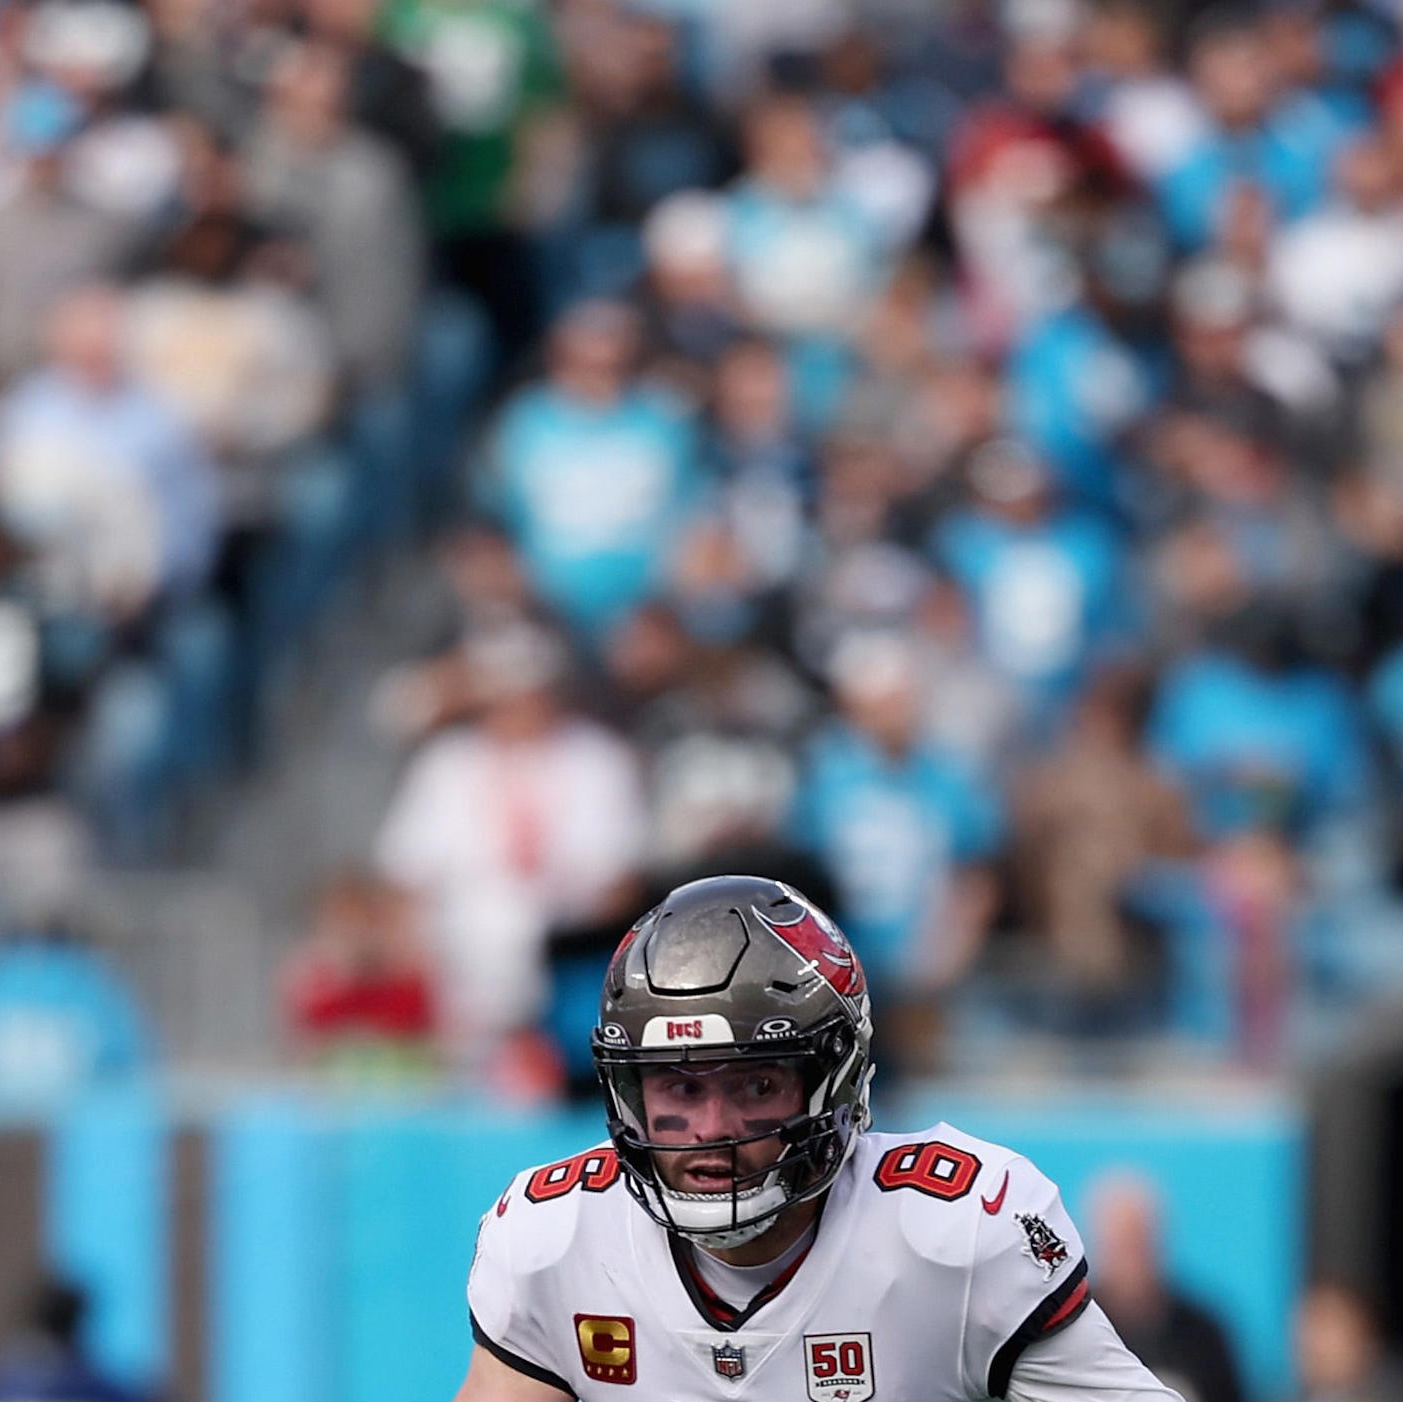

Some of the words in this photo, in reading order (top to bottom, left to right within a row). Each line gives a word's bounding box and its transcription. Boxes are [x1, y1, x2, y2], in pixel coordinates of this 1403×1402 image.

[666, 1020, 703, 1040] BUCS
[524, 1147, 621, 1205] 6
[872, 1141, 983, 1203] 6
[577, 1318, 631, 1367] C
[811, 1341, 865, 1378] 50
